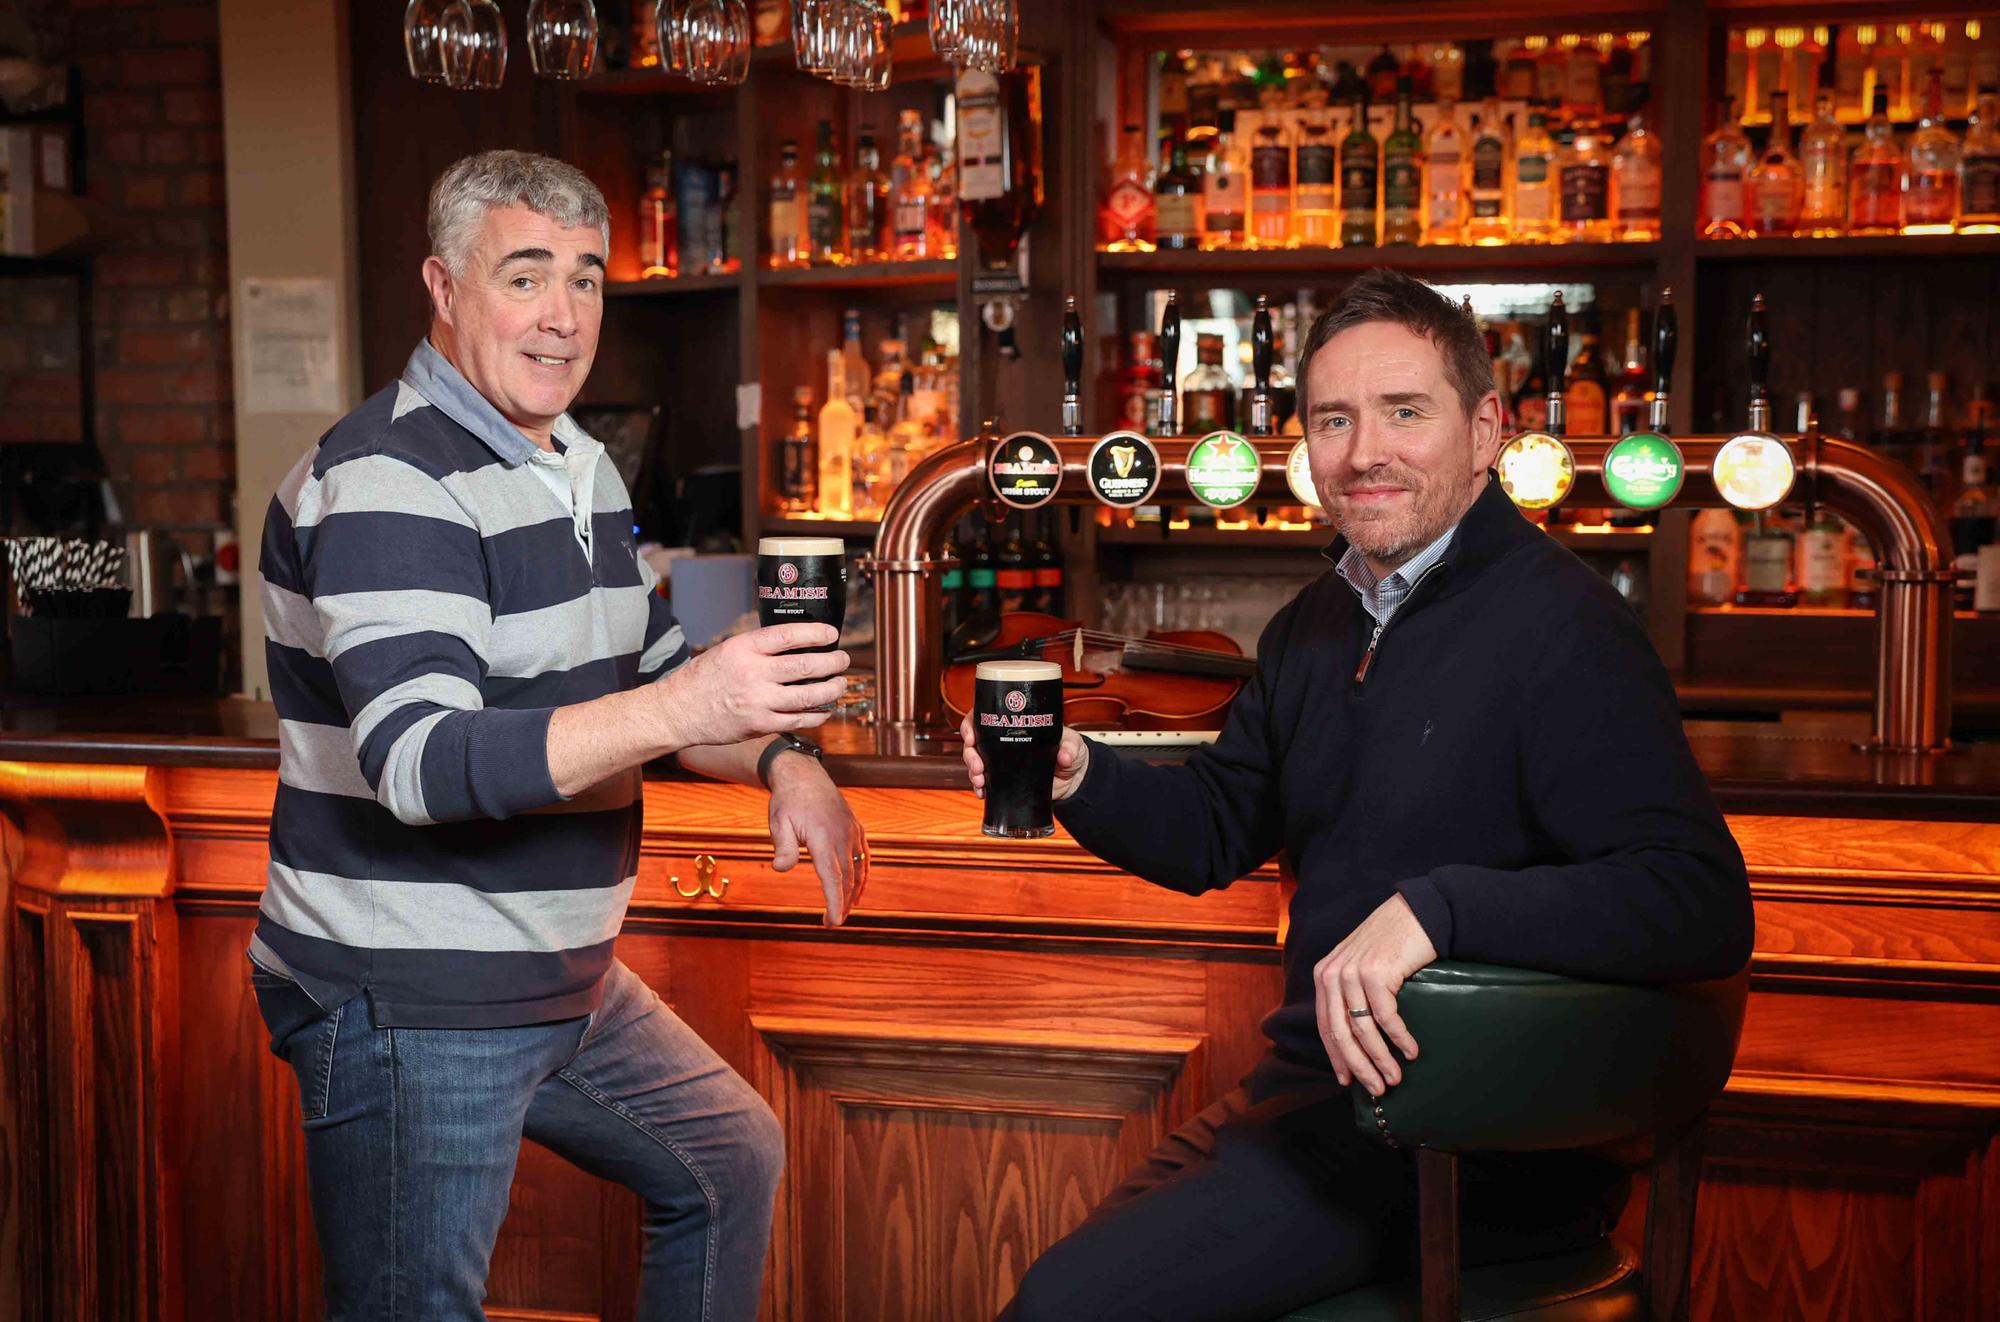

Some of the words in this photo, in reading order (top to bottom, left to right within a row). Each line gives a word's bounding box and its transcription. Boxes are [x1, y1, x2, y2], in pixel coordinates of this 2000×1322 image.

[1099, 477, 1148, 489] GUINNESS
[1023, 488, 1051, 496] STOUT
[759, 586, 828, 600] BEAMISH
[980, 713, 1054, 728] BEAMISH
